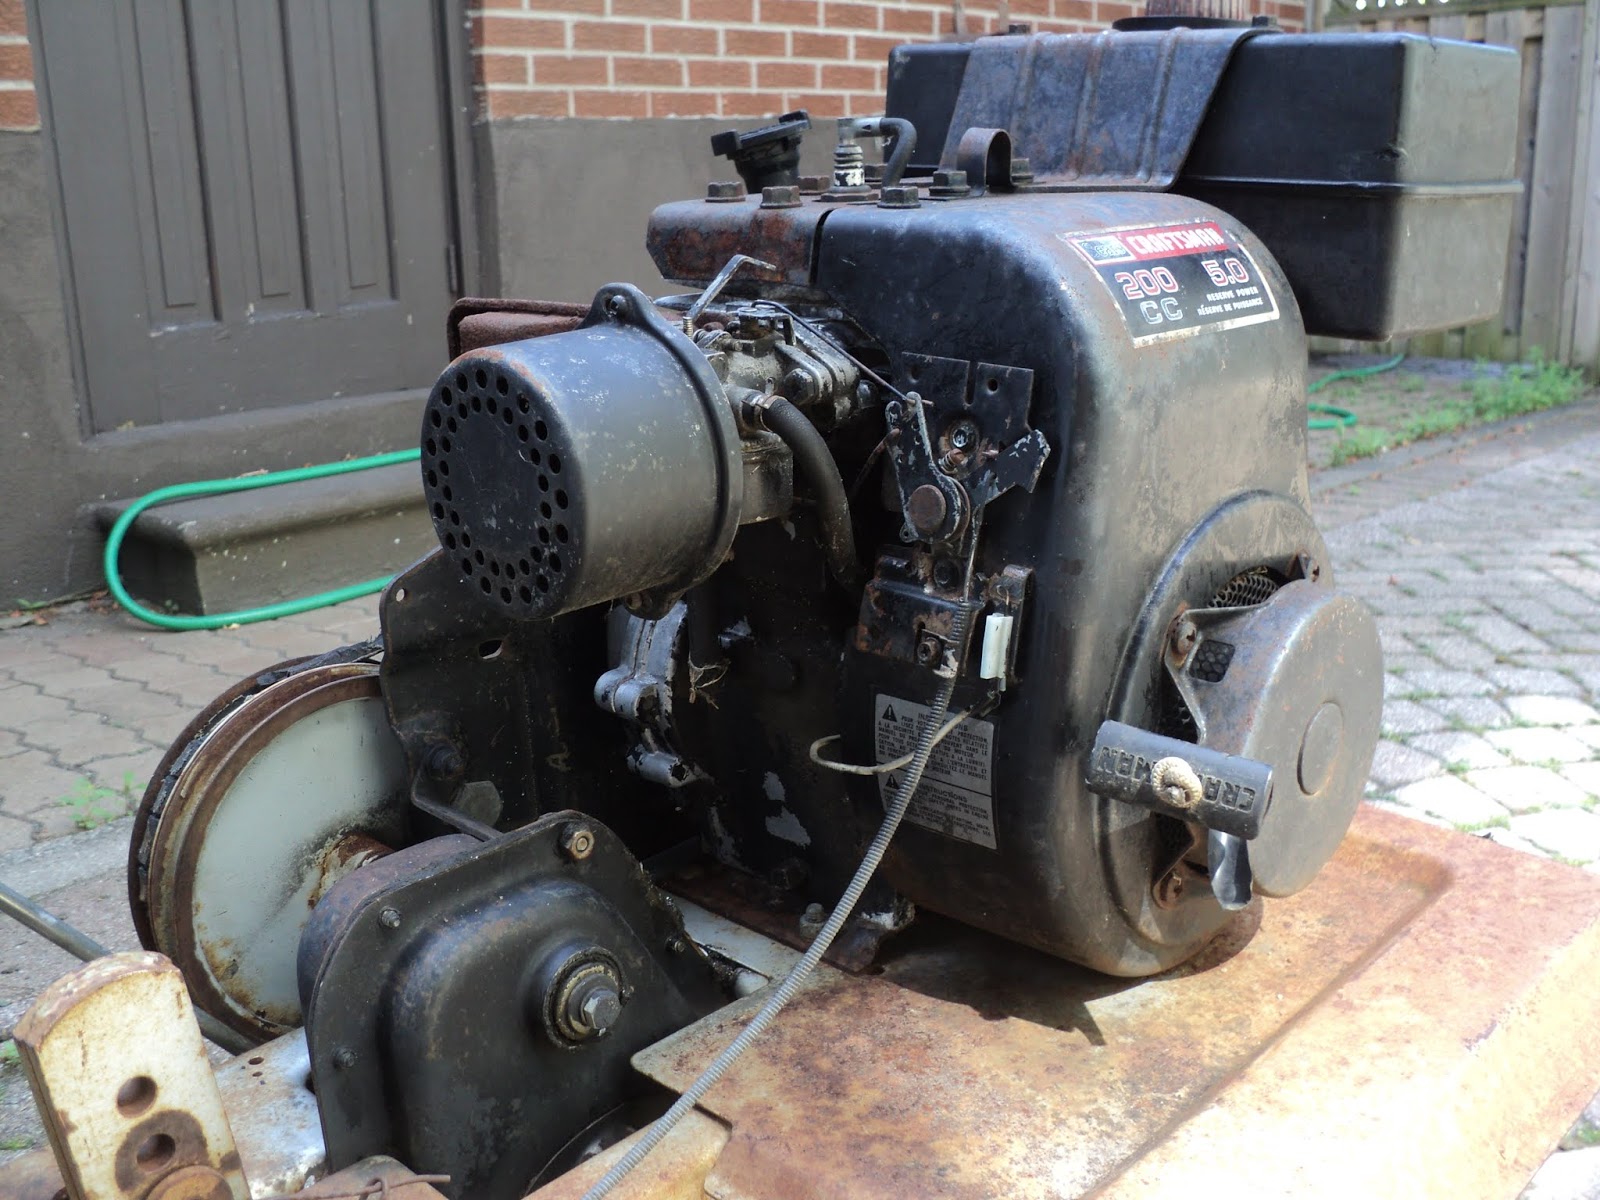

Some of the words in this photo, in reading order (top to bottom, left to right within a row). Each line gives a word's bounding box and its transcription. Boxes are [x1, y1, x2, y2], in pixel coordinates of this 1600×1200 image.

[1126, 227, 1224, 255] CRAFTSMAN
[1114, 266, 1179, 300] 200
[1201, 257, 1250, 287] 5.0
[1206, 289, 1236, 302] RESERVE
[1236, 285, 1259, 298] POWER
[1223, 302, 1234, 313] DE
[1139, 297, 1184, 325] CC
[1098, 746, 1257, 814] CRAMAN
